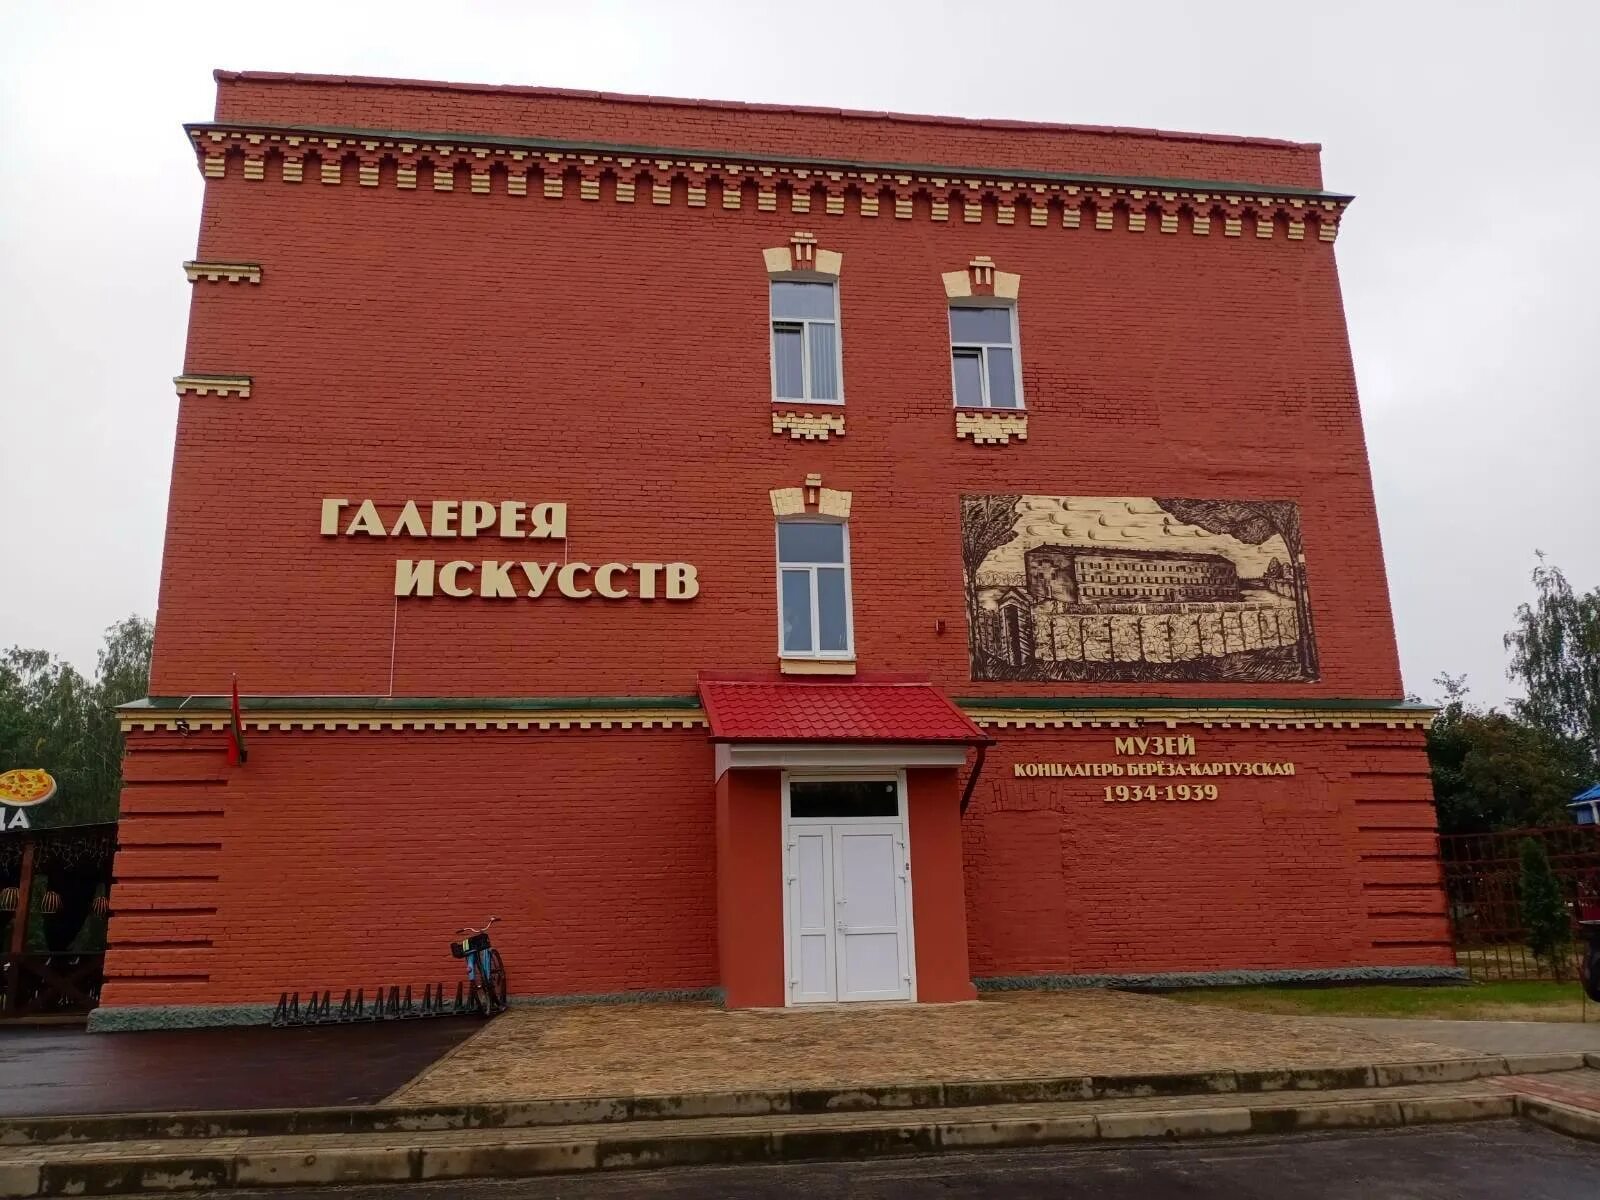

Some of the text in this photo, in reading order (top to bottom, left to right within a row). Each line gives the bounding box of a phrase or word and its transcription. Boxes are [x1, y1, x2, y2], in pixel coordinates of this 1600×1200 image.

[320, 498, 567, 538] ГАЛЕРЕЯ
[394, 559, 700, 600] ИСКУССТВ
[1114, 734, 1196, 756] МУЗЕЙ
[1014, 760, 1296, 777] КОНЦЛАГЕРЬ БЕРЁЗА-КАРТУЗСКАЯ
[1103, 784, 1219, 802] 1934-1939
[0, 807, 30, 831] А
